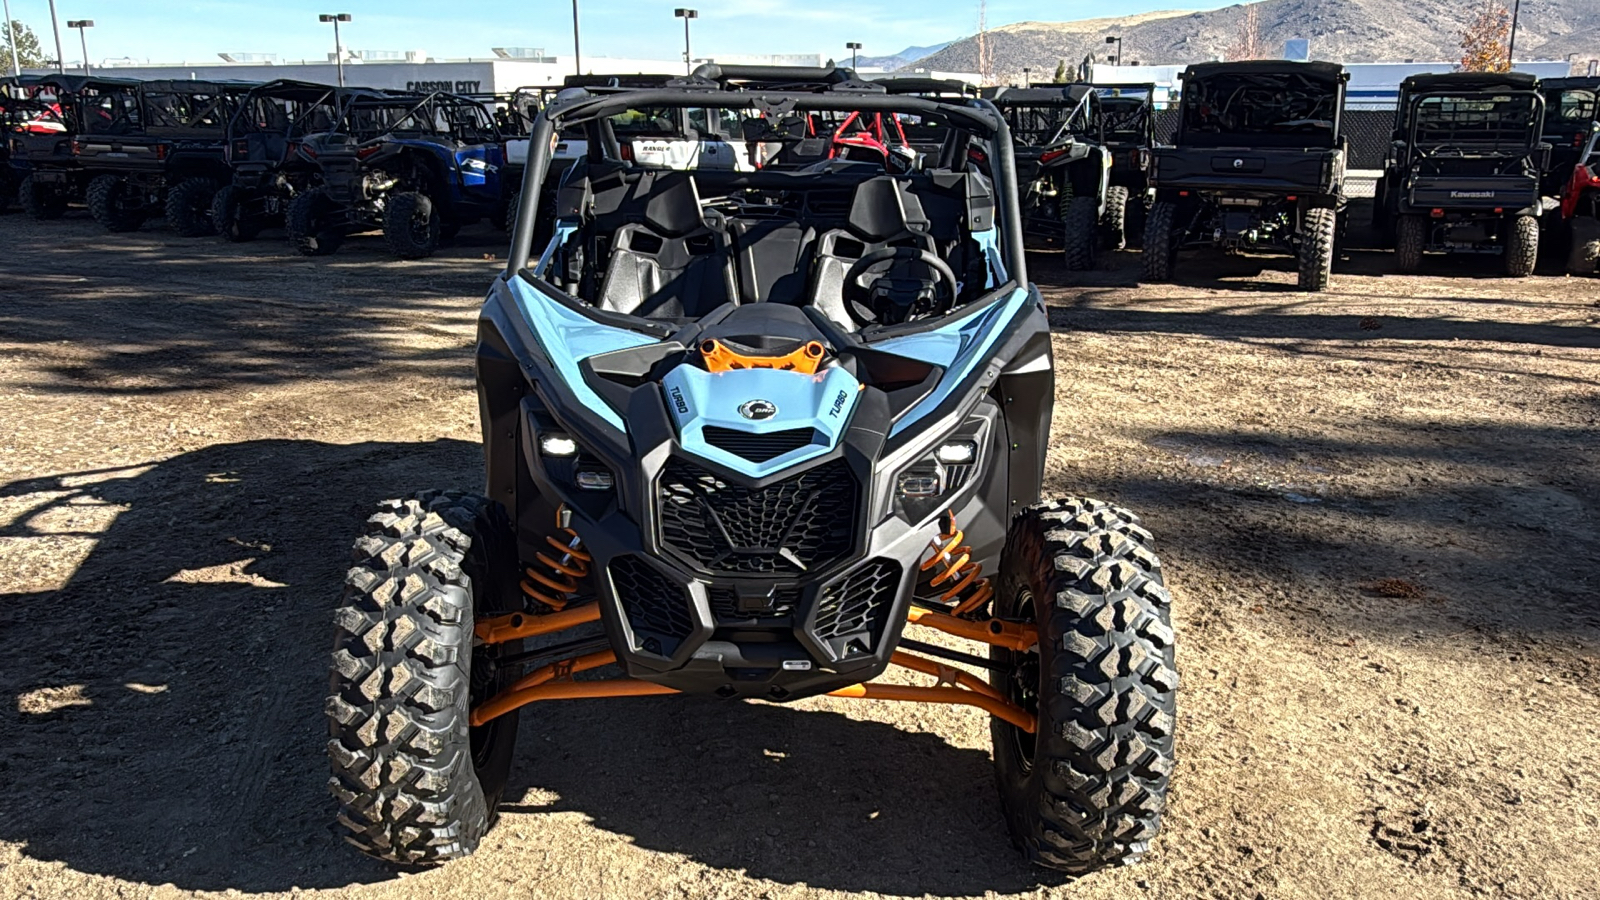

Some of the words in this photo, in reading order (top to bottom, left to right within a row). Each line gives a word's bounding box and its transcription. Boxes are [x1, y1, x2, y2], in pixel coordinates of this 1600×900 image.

[406, 80, 453, 94] CARSON
[455, 80, 481, 94] CITY
[1450, 190, 1495, 198] Kawasaki
[670, 386, 688, 414] TURBO
[829, 390, 848, 419] TURBO
